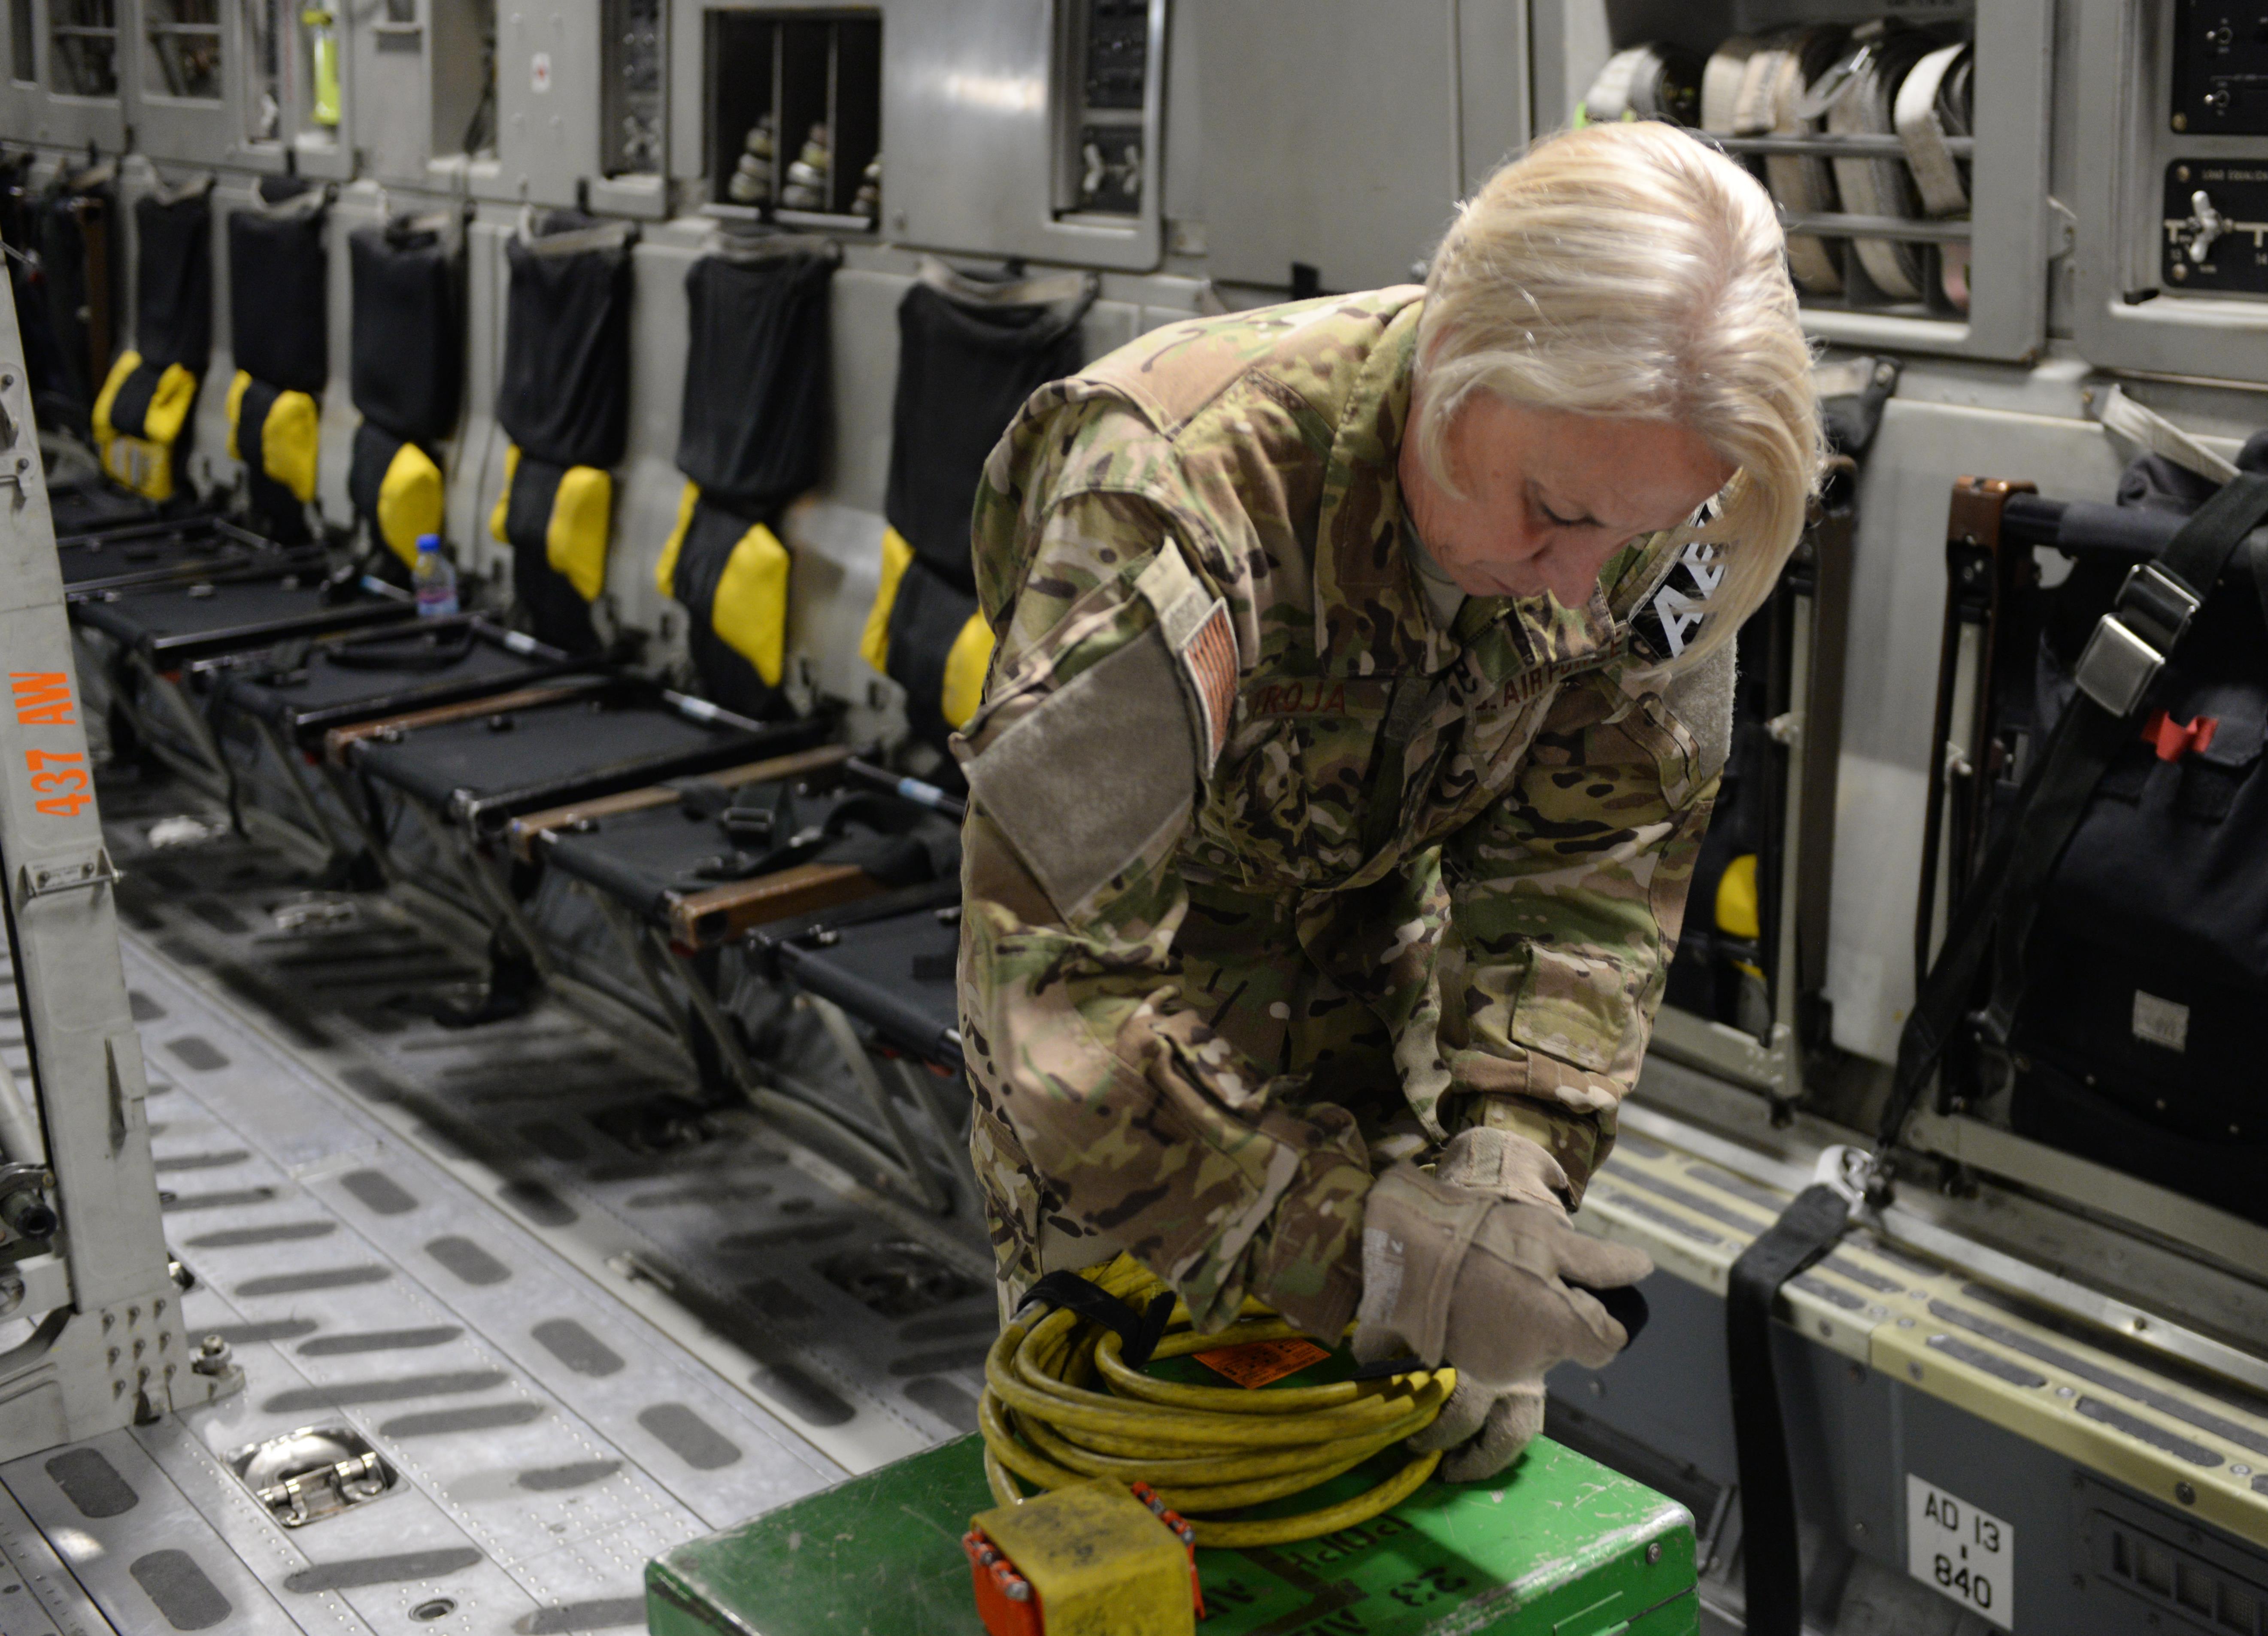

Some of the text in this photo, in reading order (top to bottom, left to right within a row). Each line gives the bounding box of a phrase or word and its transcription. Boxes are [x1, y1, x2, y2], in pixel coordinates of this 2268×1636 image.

[1503, 667, 1543, 707] AIR
[9, 672, 92, 817] 437 AW
[1924, 1491, 2001, 1554] AD 13
[1934, 1553, 1992, 1610] 840
